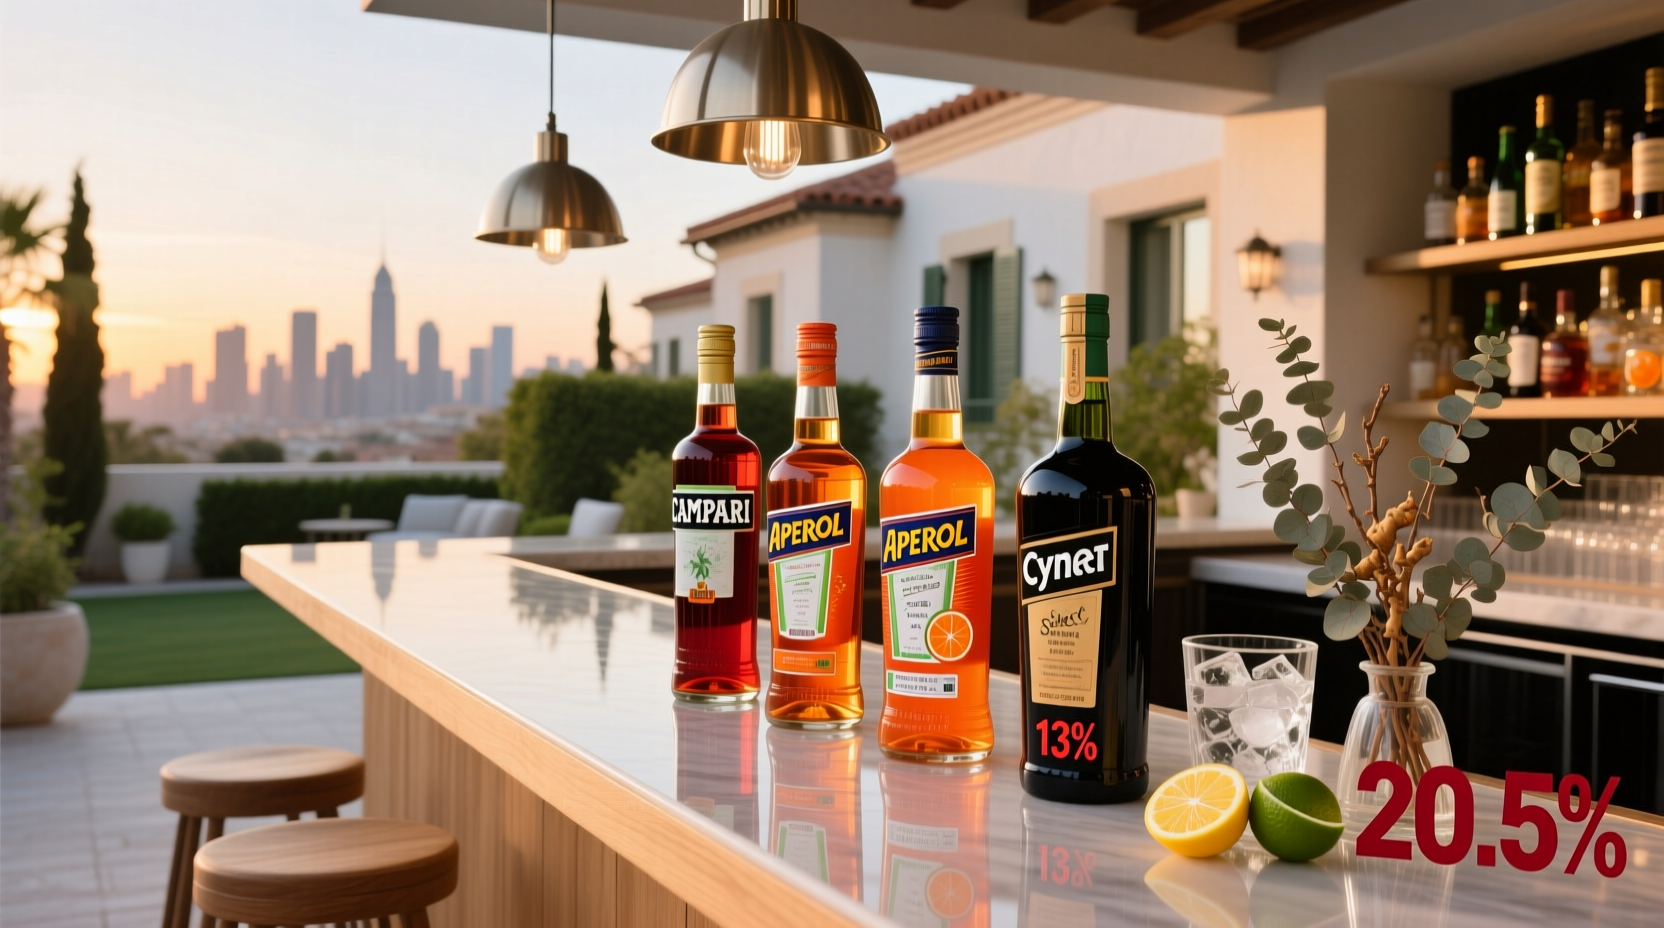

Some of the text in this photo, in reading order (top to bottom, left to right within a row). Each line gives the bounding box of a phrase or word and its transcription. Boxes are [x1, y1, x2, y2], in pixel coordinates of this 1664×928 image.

[672, 497, 751, 524] CAMPARI
[769, 512, 844, 553] APEROL
[883, 519, 968, 563] APEROL
[1036, 718, 1098, 761] 13%
